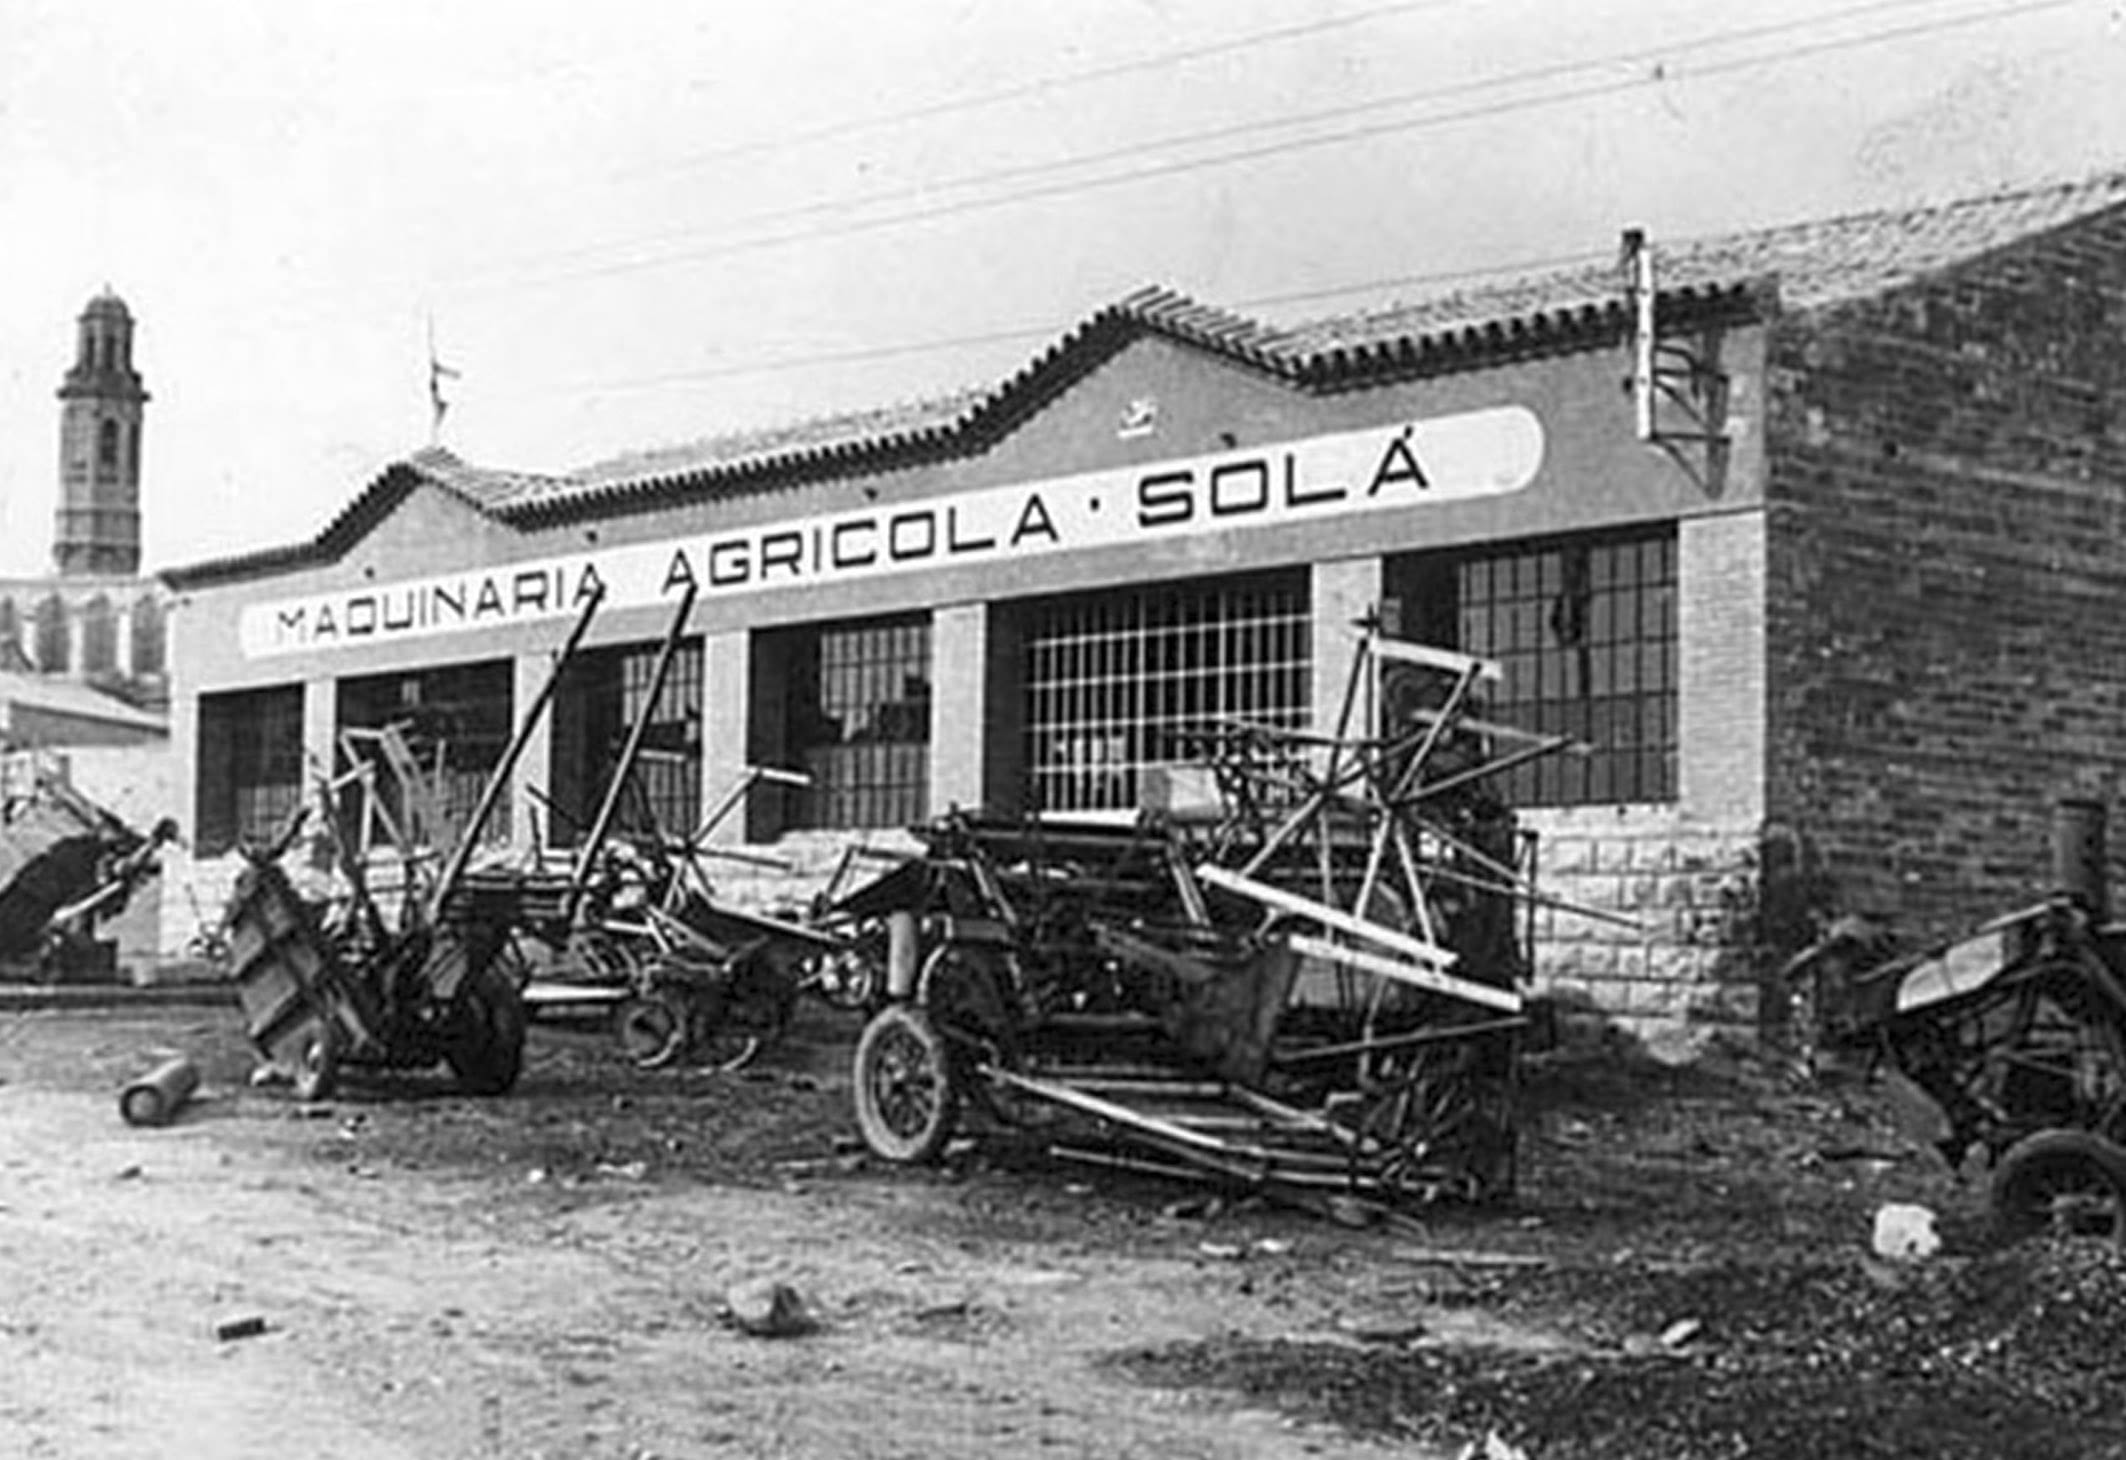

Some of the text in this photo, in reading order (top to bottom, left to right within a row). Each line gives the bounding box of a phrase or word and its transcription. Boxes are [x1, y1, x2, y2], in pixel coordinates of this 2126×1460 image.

[278, 563, 605, 641] MAQUINARIA
[661, 493, 1060, 595] AGRICOLA
[1138, 425, 1430, 527] SOLÁ
